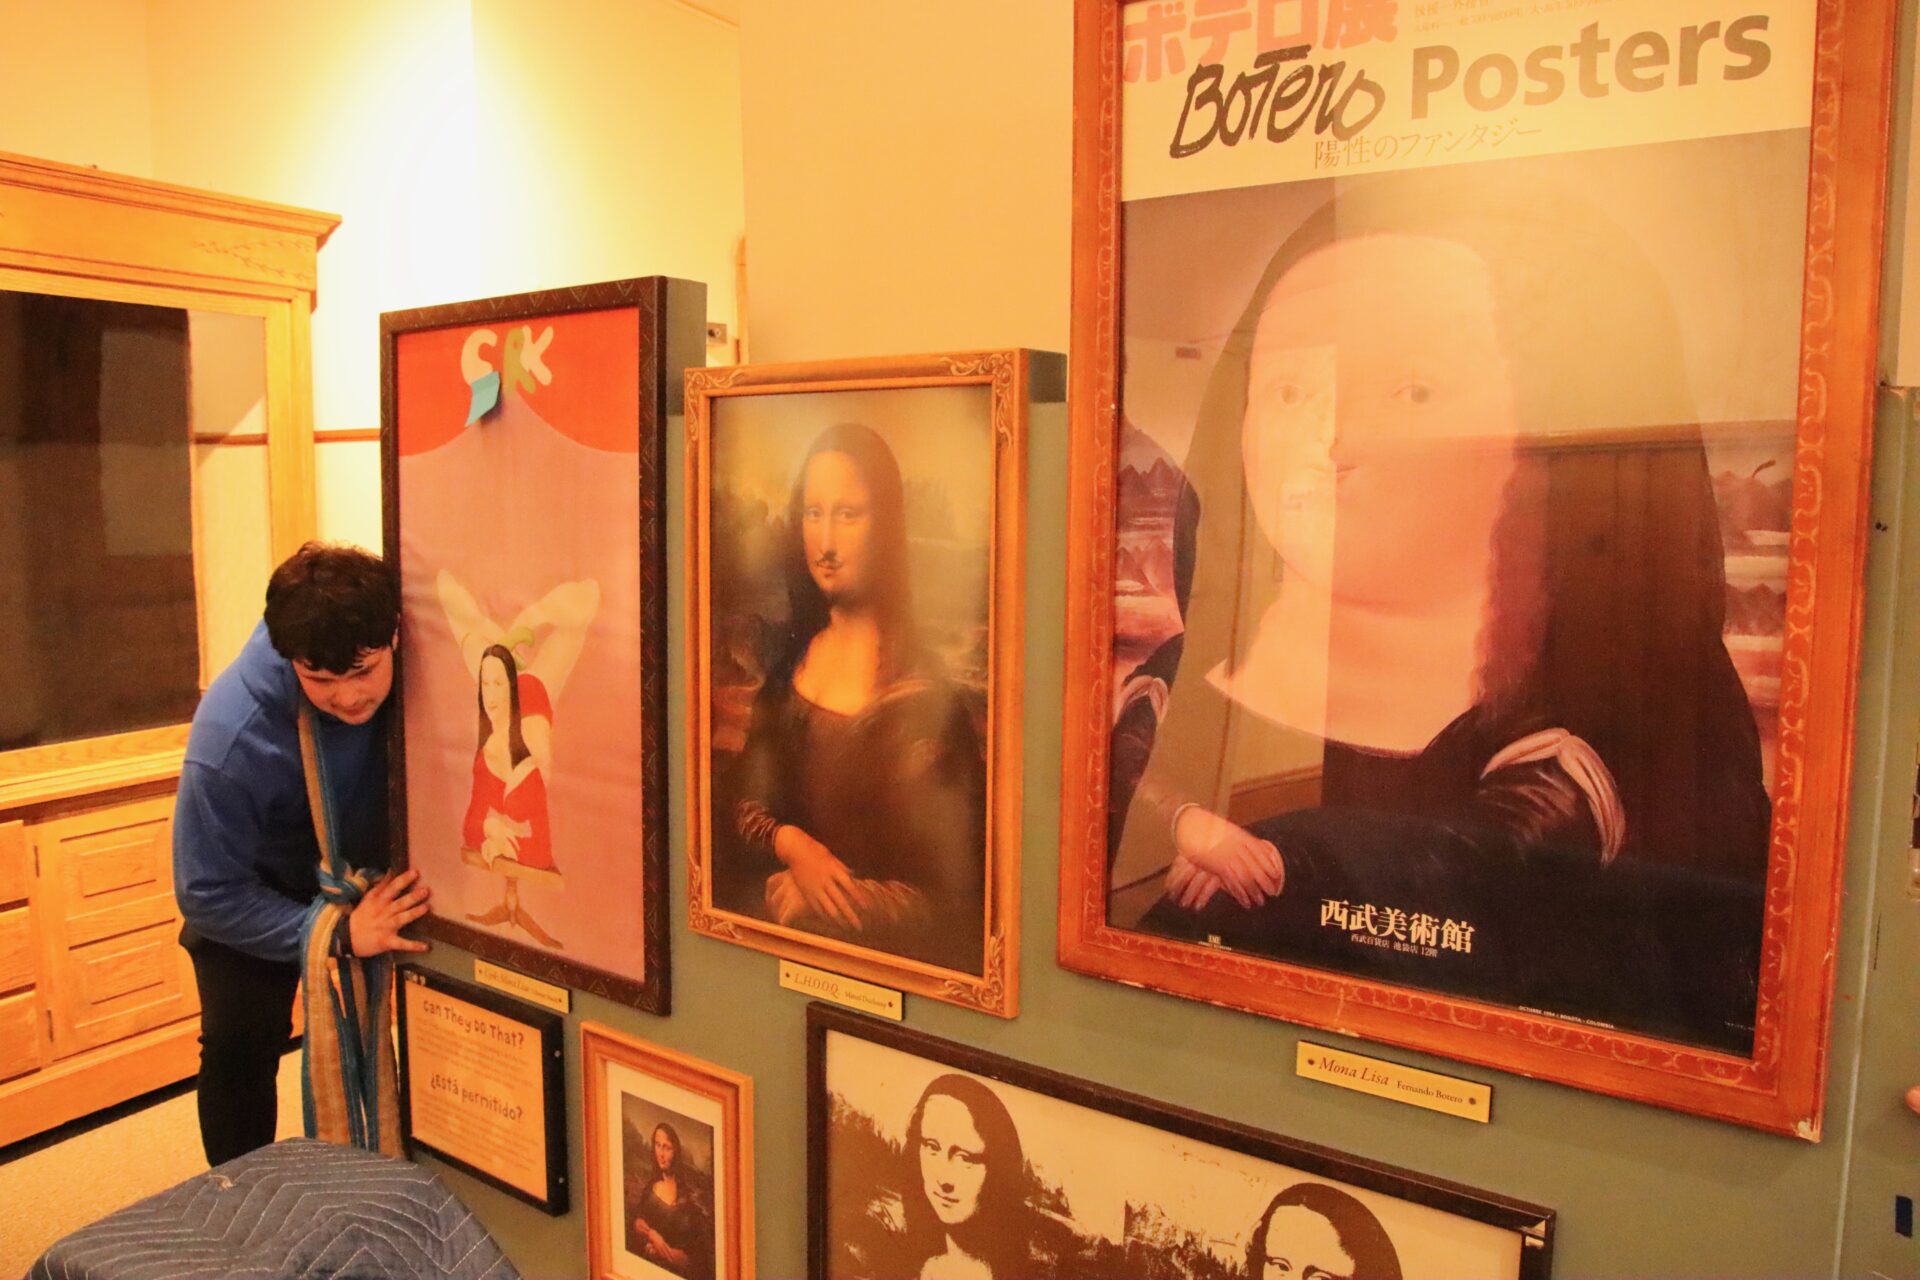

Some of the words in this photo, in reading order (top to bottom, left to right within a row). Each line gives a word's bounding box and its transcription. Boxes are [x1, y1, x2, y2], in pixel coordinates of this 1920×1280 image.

[1124, 0, 1398, 83] ボテロ展
[1411, 14, 1772, 120] Posters
[1314, 117, 1542, 170] 陽性のファンタジー
[1319, 899, 1476, 954] 西武美術館
[444, 1006, 472, 1034] They
[489, 1024, 525, 1047] That?
[461, 1086, 524, 1121] permitido?
[1318, 1056, 1357, 1079] Mona
[1360, 1066, 1390, 1087] Lisa
[1396, 1079, 1435, 1098] Fernando
[1436, 1088, 1463, 1105] Botero
